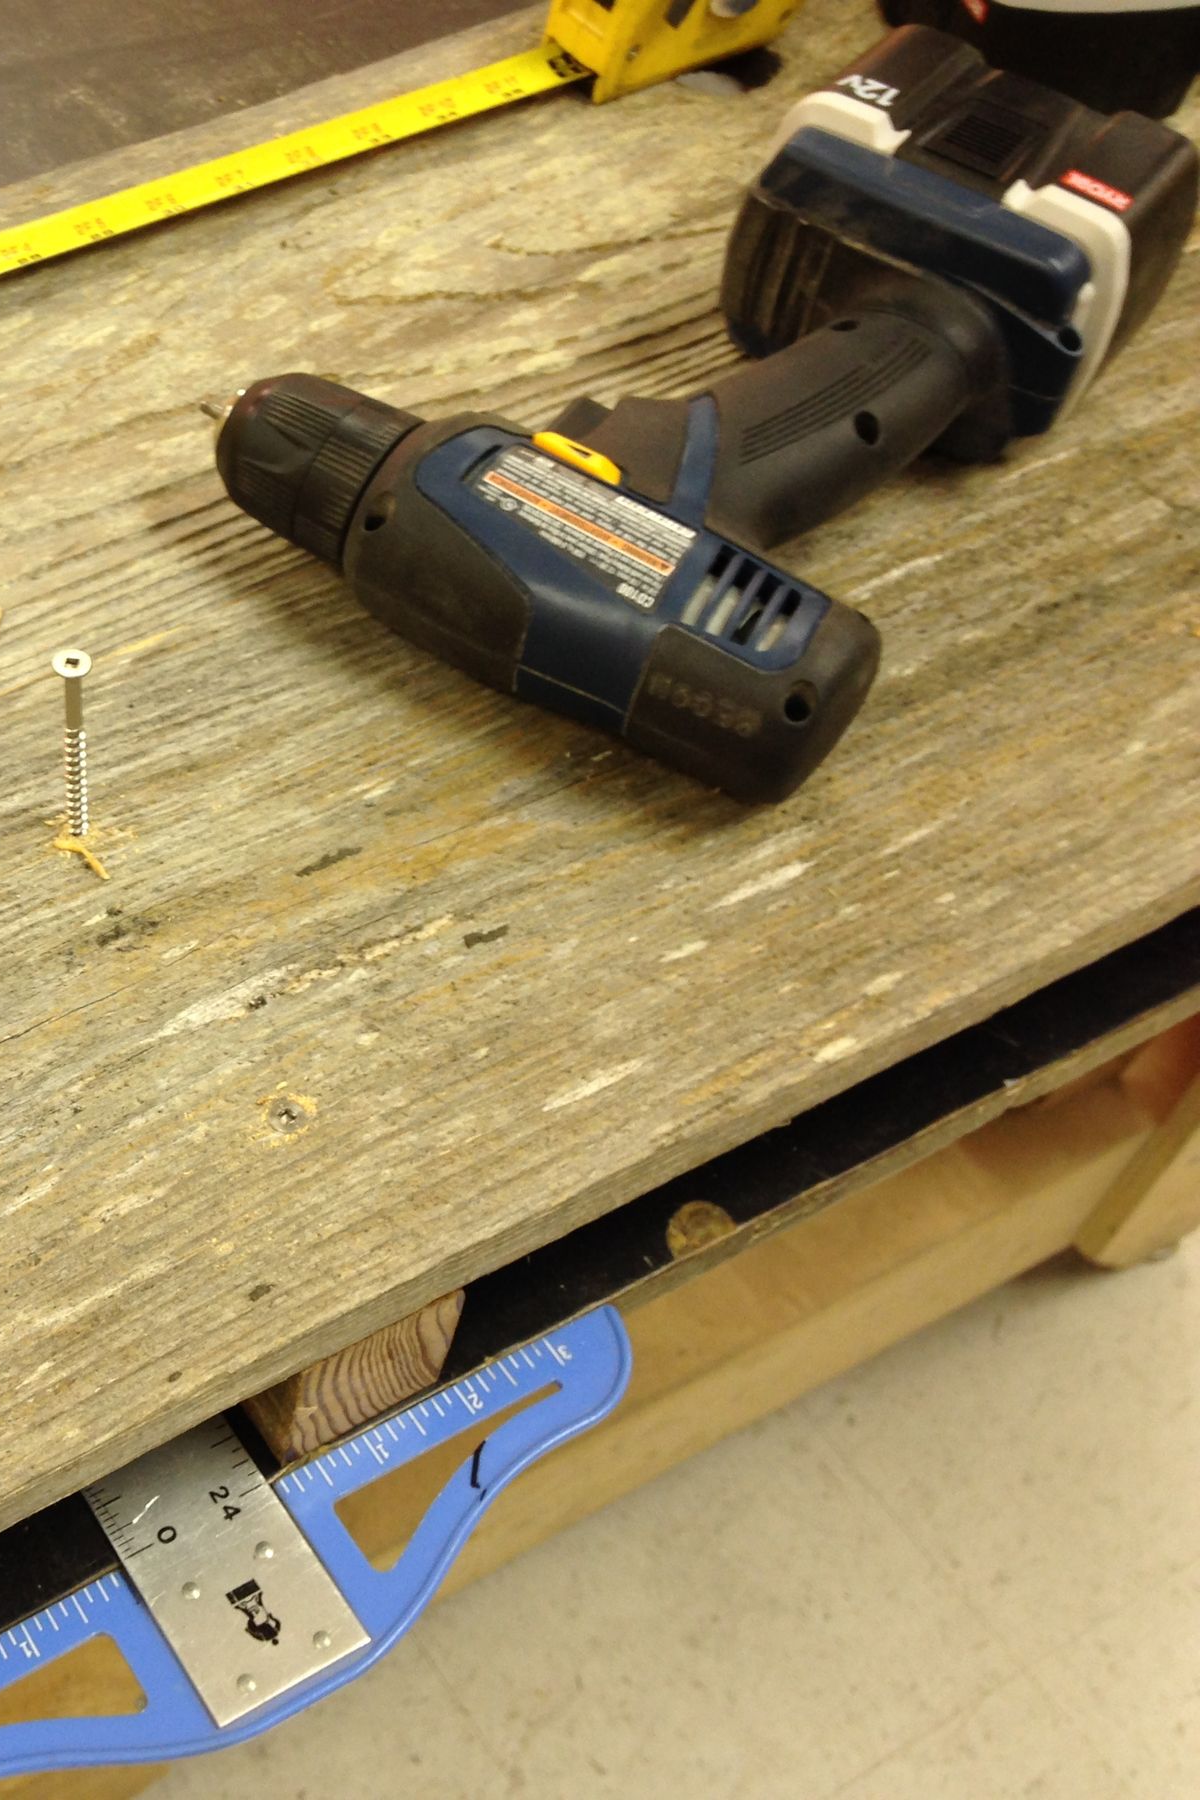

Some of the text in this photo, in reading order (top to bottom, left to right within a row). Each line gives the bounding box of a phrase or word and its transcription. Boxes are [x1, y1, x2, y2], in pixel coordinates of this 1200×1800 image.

[835, 75, 900, 107] 12V
[557, 1345, 573, 1360] 3
[468, 1393, 484, 1409] 2
[376, 1444, 390, 1459] 1
[209, 1486, 241, 1521] 24
[157, 1526, 177, 1544] 0
[19, 1641, 33, 1659] 1
